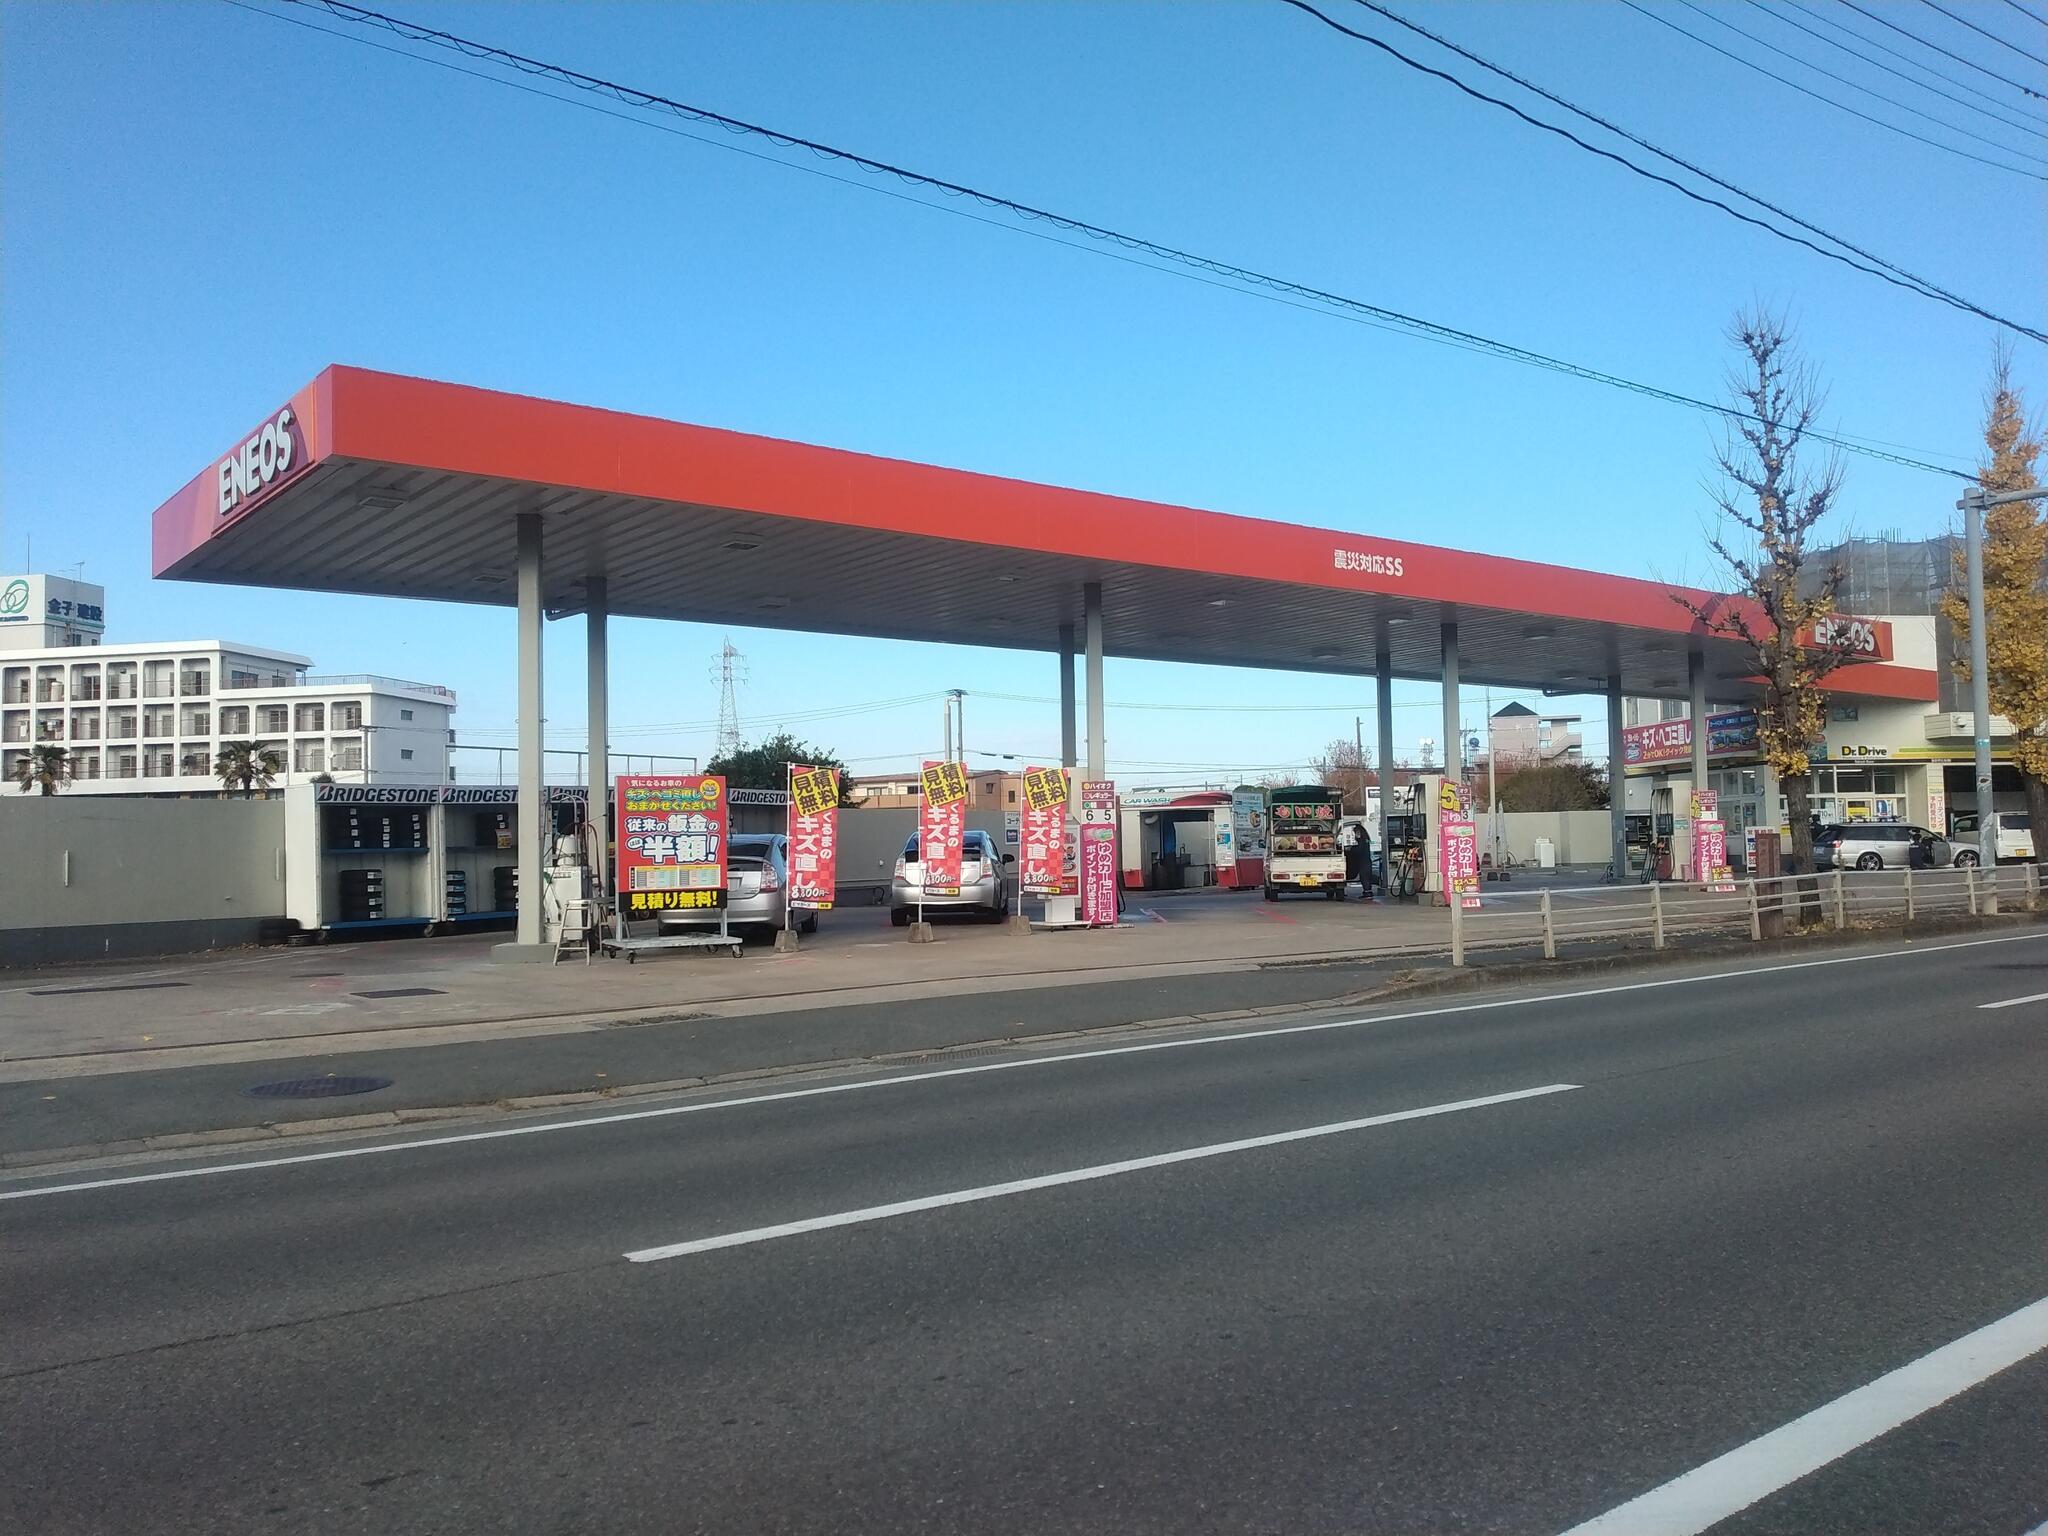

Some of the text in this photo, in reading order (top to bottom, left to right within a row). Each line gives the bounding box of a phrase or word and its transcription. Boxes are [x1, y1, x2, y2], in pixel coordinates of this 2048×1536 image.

[219, 410, 296, 515] ENEOS
[1334, 549, 1404, 577] 震災対応SS
[320, 786, 439, 802] BRIDGESTONE
[441, 787, 519, 802] BRIDGEST
[731, 790, 787, 803] BRIDGESTO
[820, 812, 833, 860] くるまの
[948, 803, 960, 847] くるまの
[1049, 807, 1061, 850] くるまの
[1086, 810, 1112, 821] 6 5
[1462, 811, 1469, 820] 3
[794, 816, 819, 889] キズ直し
[926, 806, 948, 875] キズ直し
[1027, 810, 1048, 876] キズ直し
[1459, 838, 1473, 877] ゆめカード
